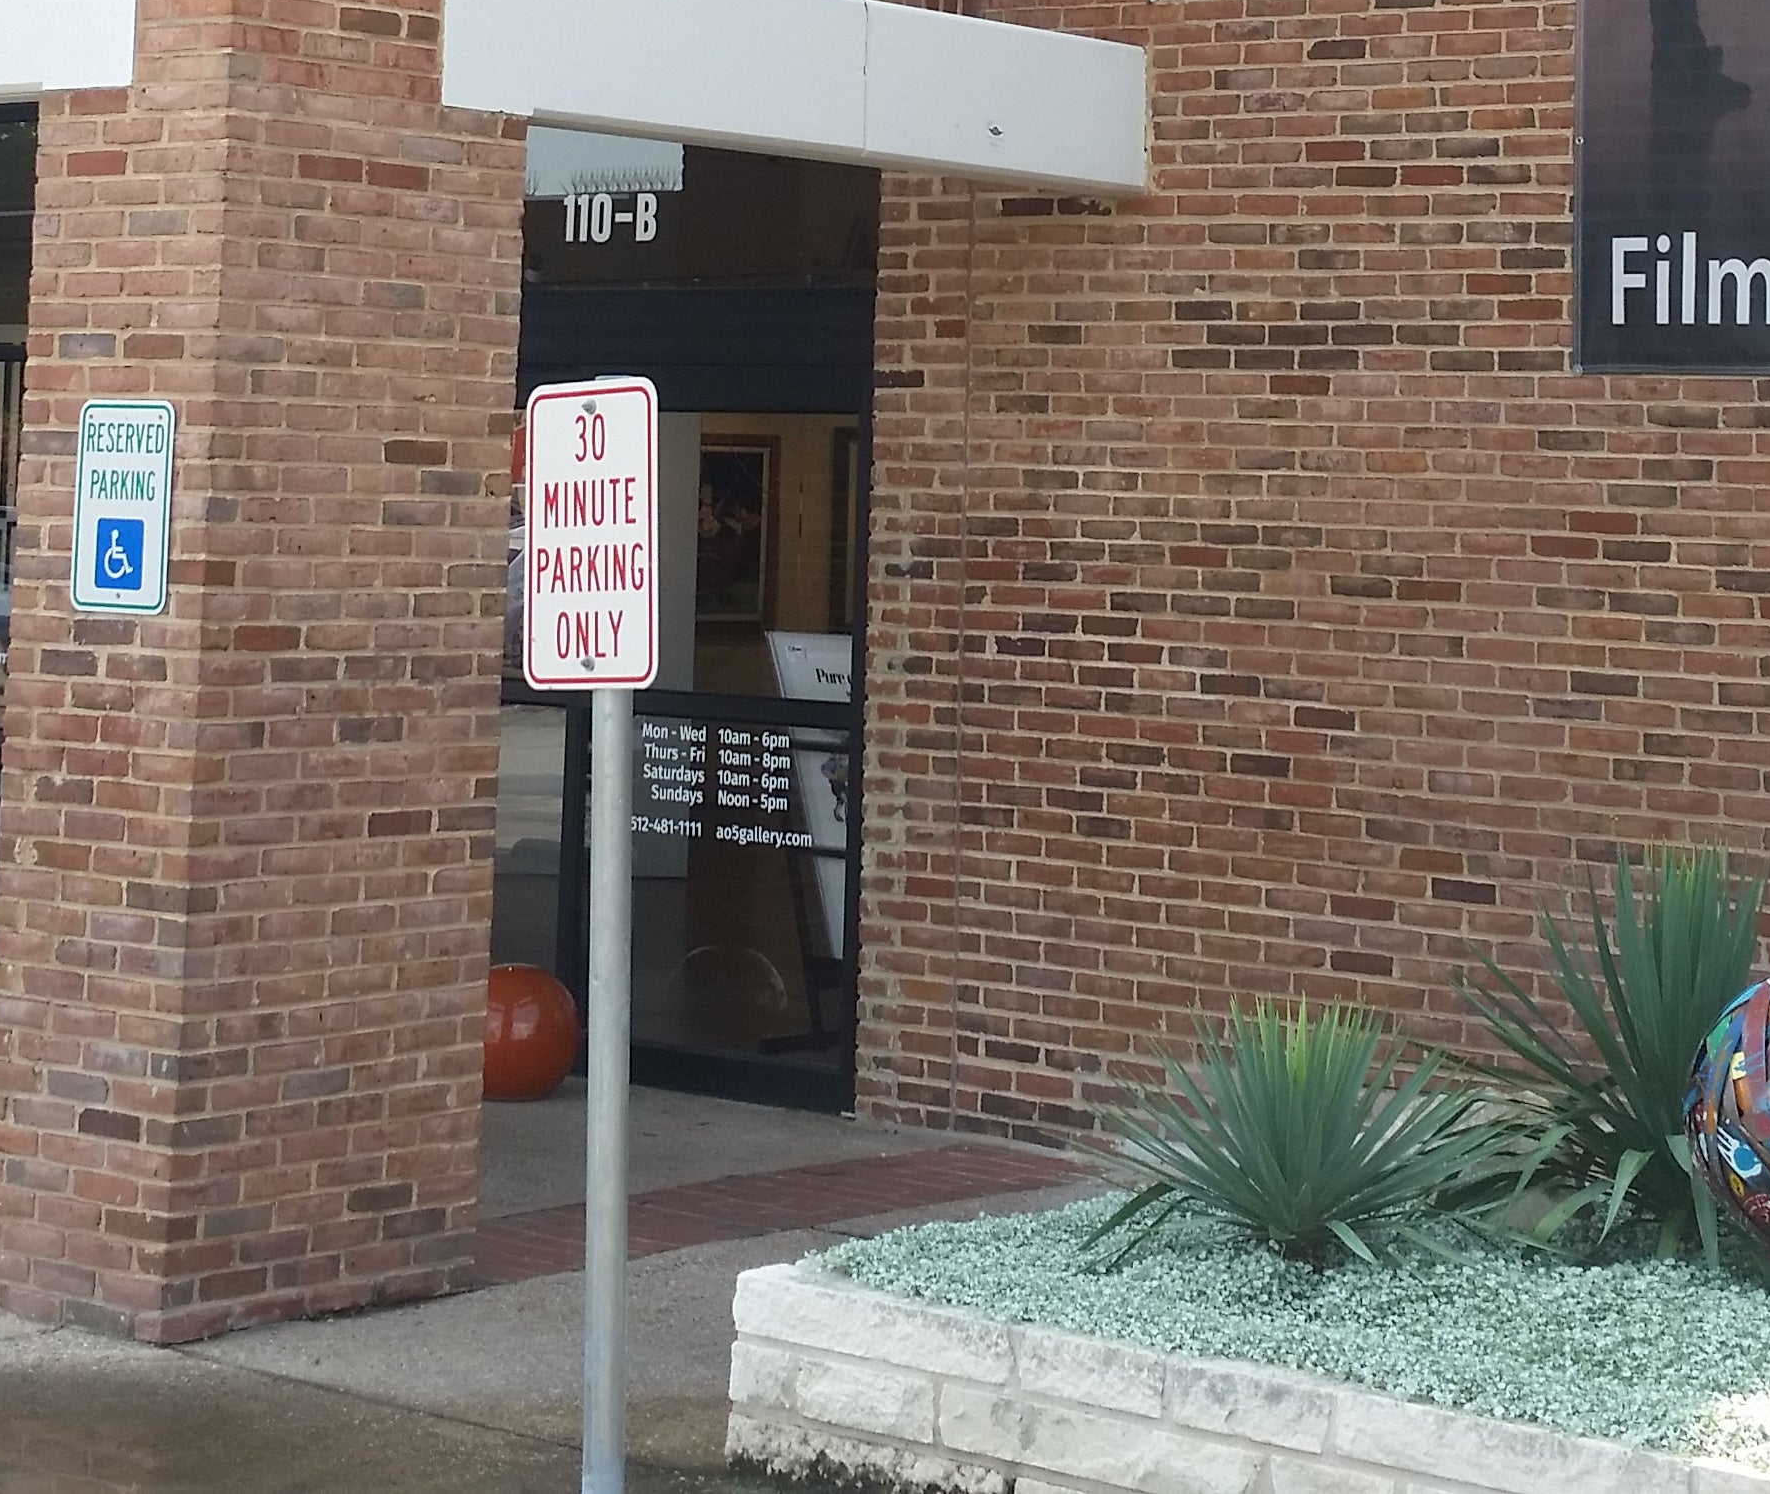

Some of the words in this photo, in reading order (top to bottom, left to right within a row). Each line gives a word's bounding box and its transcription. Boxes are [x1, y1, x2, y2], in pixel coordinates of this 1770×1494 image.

[563, 192, 658, 243] 110-B
[86, 422, 165, 454] RESERVED
[575, 413, 605, 462] 30
[90, 469, 156, 501] PARKING
[544, 476, 636, 529] MINUTE
[536, 542, 645, 594] PARKING
[556, 609, 624, 659] ONLY
[641, 722, 669, 740] Mon
[680, 725, 707, 743] Wed
[717, 728, 751, 746] 10am
[762, 731, 790, 751] 6pm
[644, 743, 679, 761] Thurs
[690, 746, 706, 763] Fri
[718, 749, 751, 767] 10am
[762, 753, 791, 772] 8pm
[643, 763, 705, 786] Saturdays
[717, 769, 750, 788] 10am
[761, 774, 790, 793] 6pm
[651, 784, 704, 806] Sundays
[717, 790, 750, 807] Noon
[760, 794, 788, 814] 5pm
[631, 815, 702, 838] 512-481-1111
[715, 824, 813, 848] ao5gallery.com
